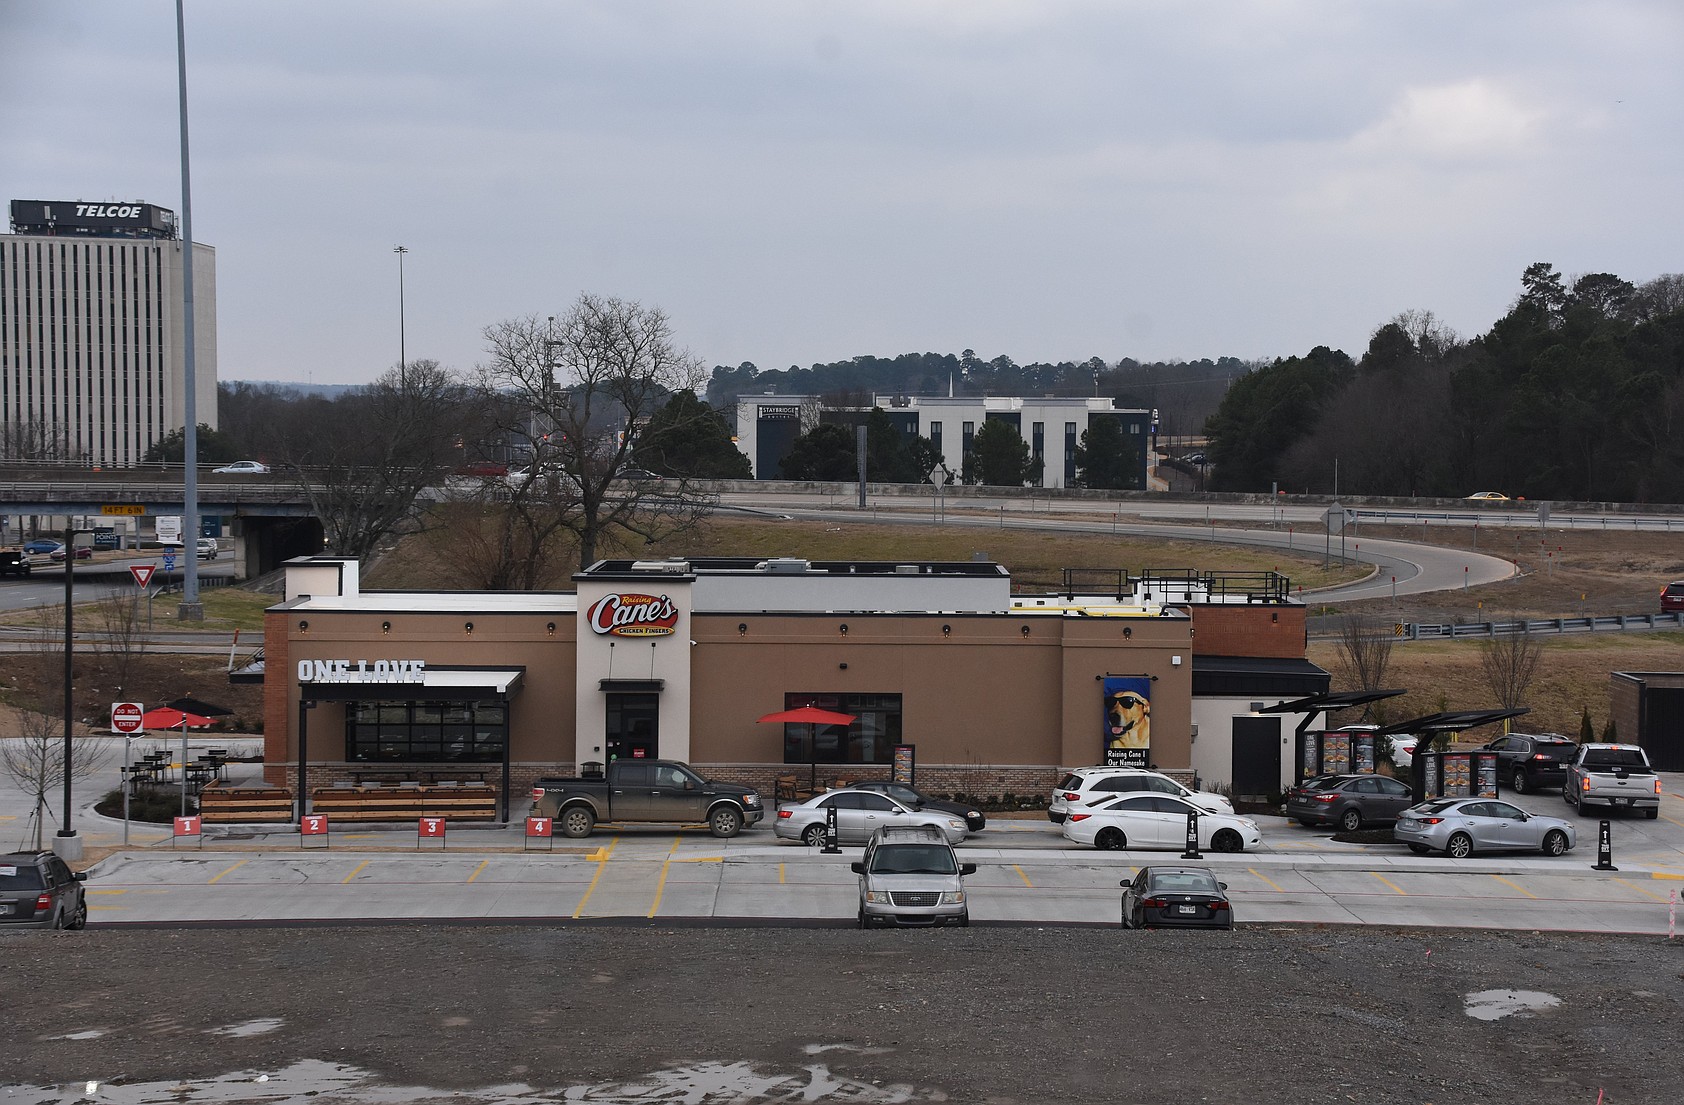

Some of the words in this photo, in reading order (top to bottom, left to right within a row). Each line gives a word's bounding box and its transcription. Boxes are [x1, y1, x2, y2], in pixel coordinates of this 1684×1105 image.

[76, 205, 142, 218] TELCOE
[104, 507, 113, 515] 14
[114, 507, 124, 515] FT
[127, 507, 133, 515] 6
[134, 507, 143, 515] IN
[622, 596, 653, 605] Raising
[591, 594, 677, 634] Cane's
[298, 660, 351, 681] ONE
[357, 660, 425, 681] LOVE
[1107, 750, 1127, 760] Raising
[1128, 750, 1142, 758] Cane
[1107, 758, 1118, 767] Our
[1119, 758, 1146, 767] Namesake
[184, 821, 191, 831] 1
[310, 820, 320, 831] 2
[428, 823, 437, 833] 3
[535, 822, 544, 832] 4
